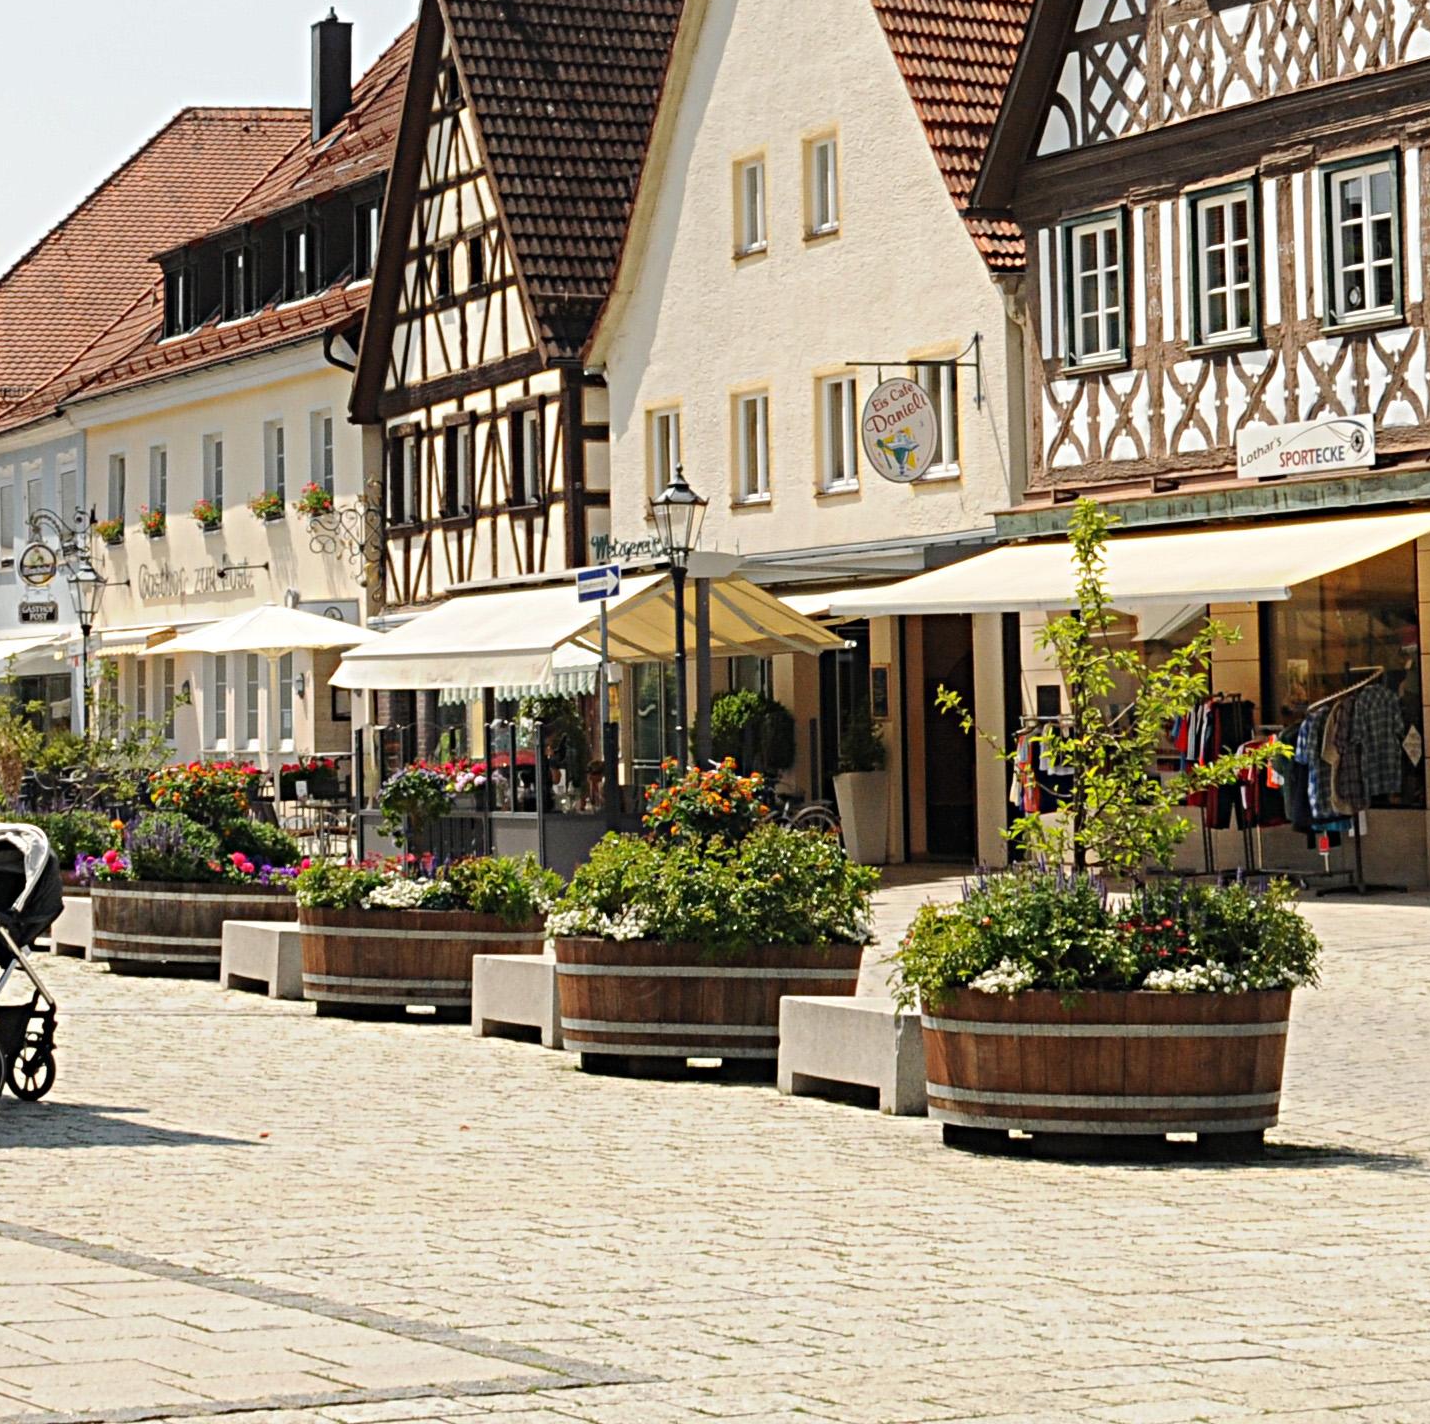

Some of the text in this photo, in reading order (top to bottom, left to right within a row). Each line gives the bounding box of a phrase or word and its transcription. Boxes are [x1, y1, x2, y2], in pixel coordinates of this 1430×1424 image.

[865, 392, 927, 433] Danieli
[872, 398, 889, 412] Eis
[1240, 436, 1282, 467] Lothar's
[1279, 445, 1345, 468] SPORTECKE
[30, 612, 47, 621] POST
